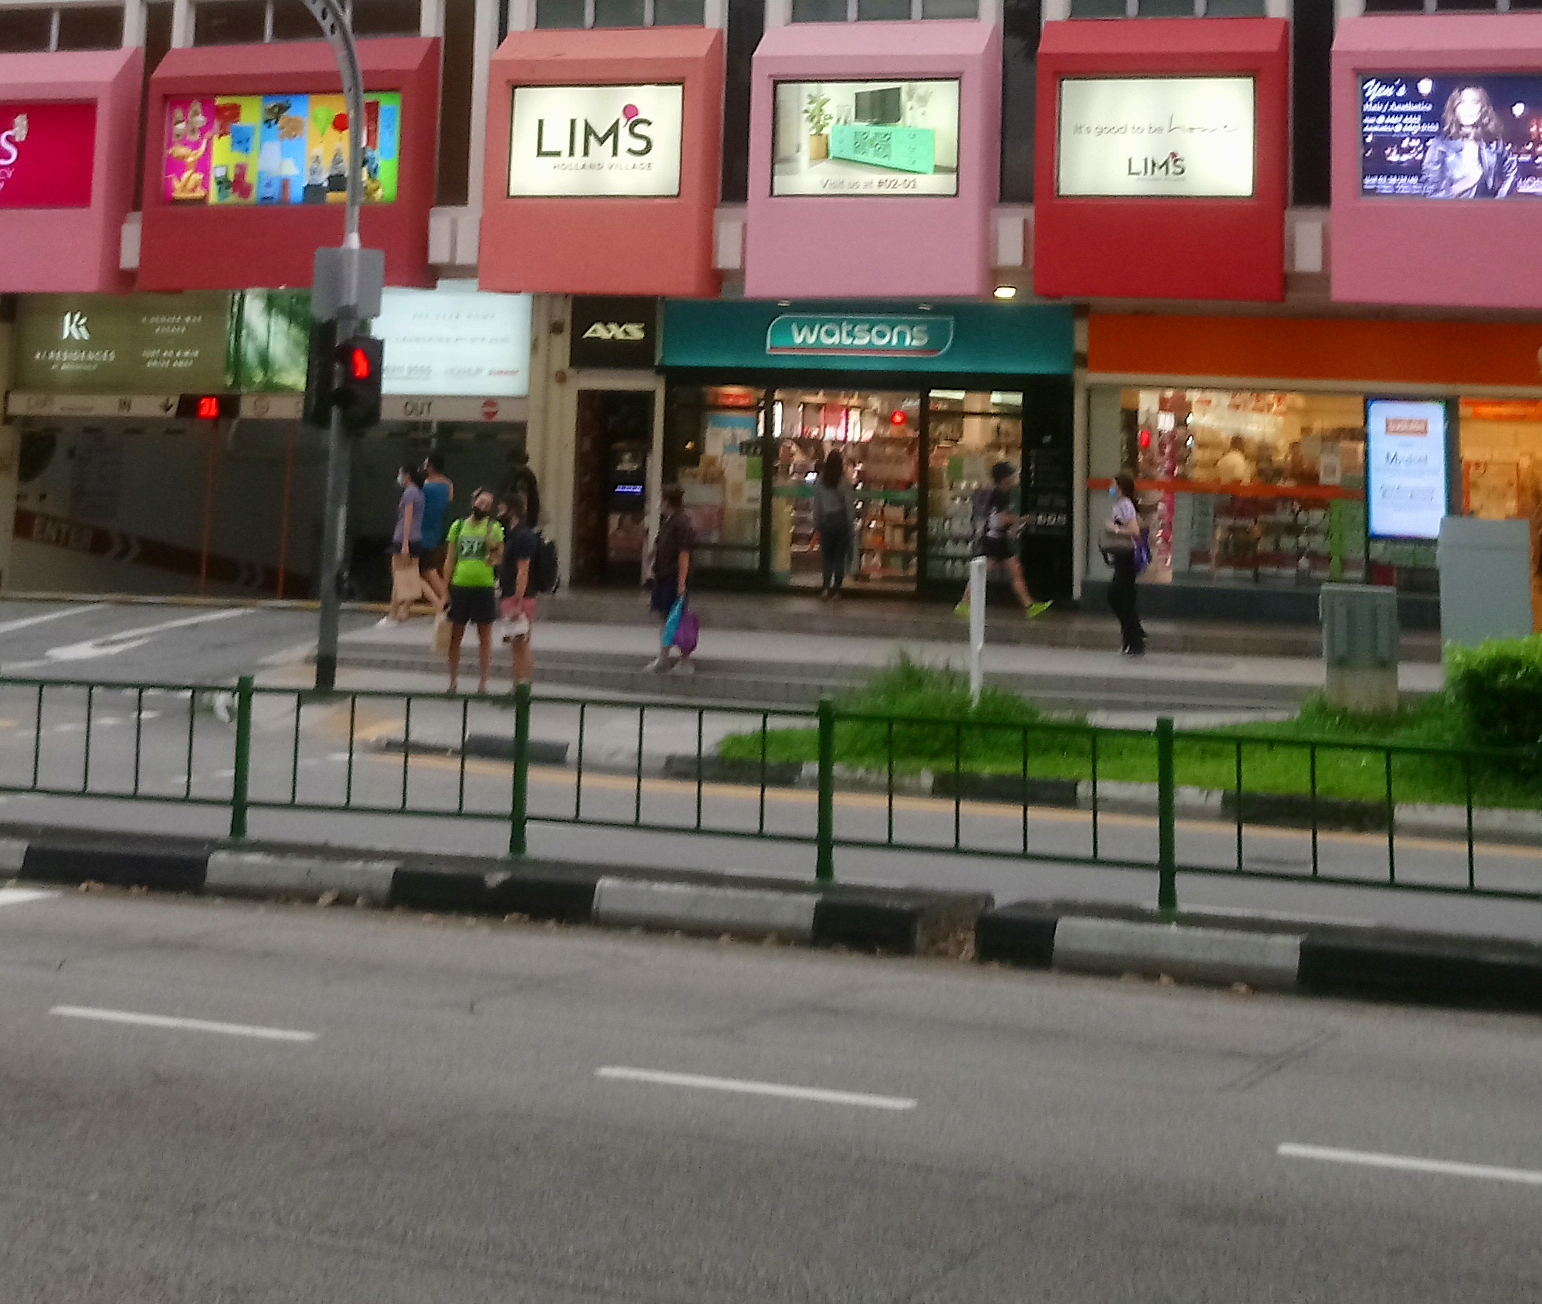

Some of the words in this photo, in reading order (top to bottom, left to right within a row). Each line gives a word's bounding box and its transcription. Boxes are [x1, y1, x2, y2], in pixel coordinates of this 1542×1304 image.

[536, 104, 653, 158] LIM'S
[1094, 123, 1128, 136] good
[1131, 123, 1146, 135] to
[1147, 123, 1164, 135] be
[553, 162, 604, 171] HOLLAND
[608, 162, 653, 171] VILLAGE
[1127, 151, 1186, 176] LIM'S
[822, 178, 844, 189] Visit
[848, 180, 860, 189] us
[863, 179, 873, 189] at
[877, 178, 918, 190] #02-01
[581, 322, 646, 341] AXS
[791, 321, 929, 347] watsons
[404, 401, 432, 416] OUT
